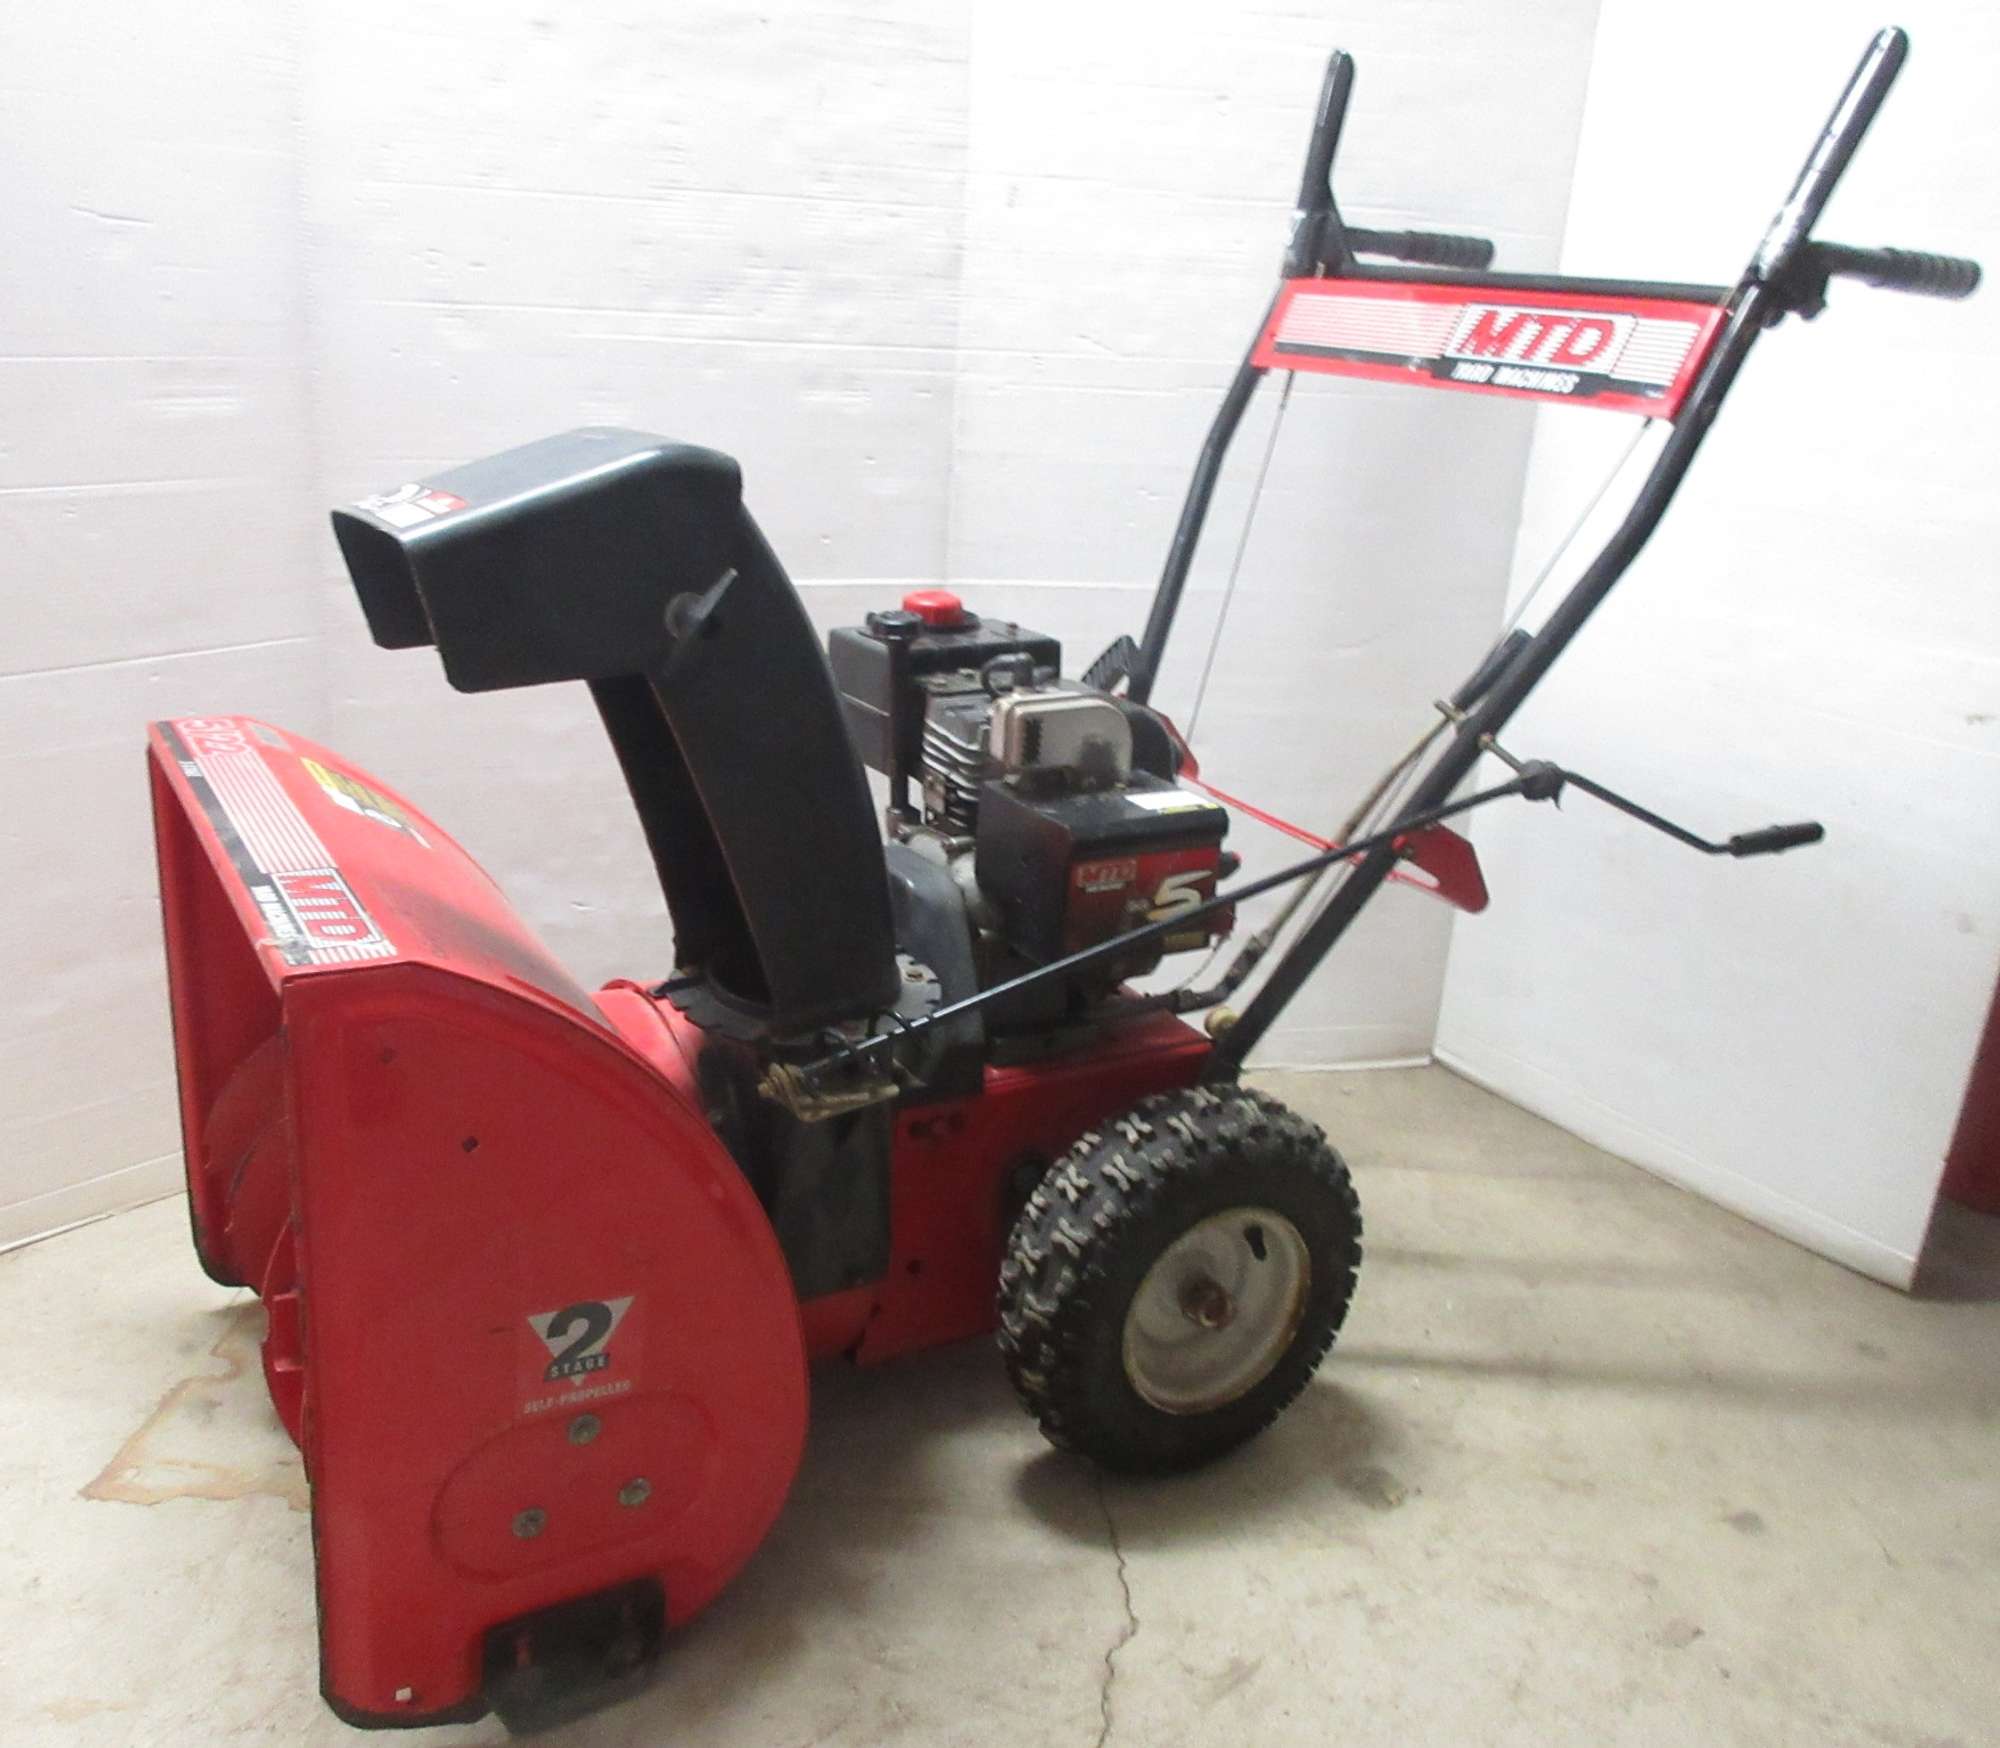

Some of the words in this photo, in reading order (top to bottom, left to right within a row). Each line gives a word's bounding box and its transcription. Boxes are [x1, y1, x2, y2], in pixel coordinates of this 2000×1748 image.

[1457, 309, 1615, 365] MTD
[278, 875, 370, 941] MTD
[1143, 869, 1213, 922] 5
[543, 1302, 613, 1381] 2
[551, 1355, 606, 1378] STAGE
